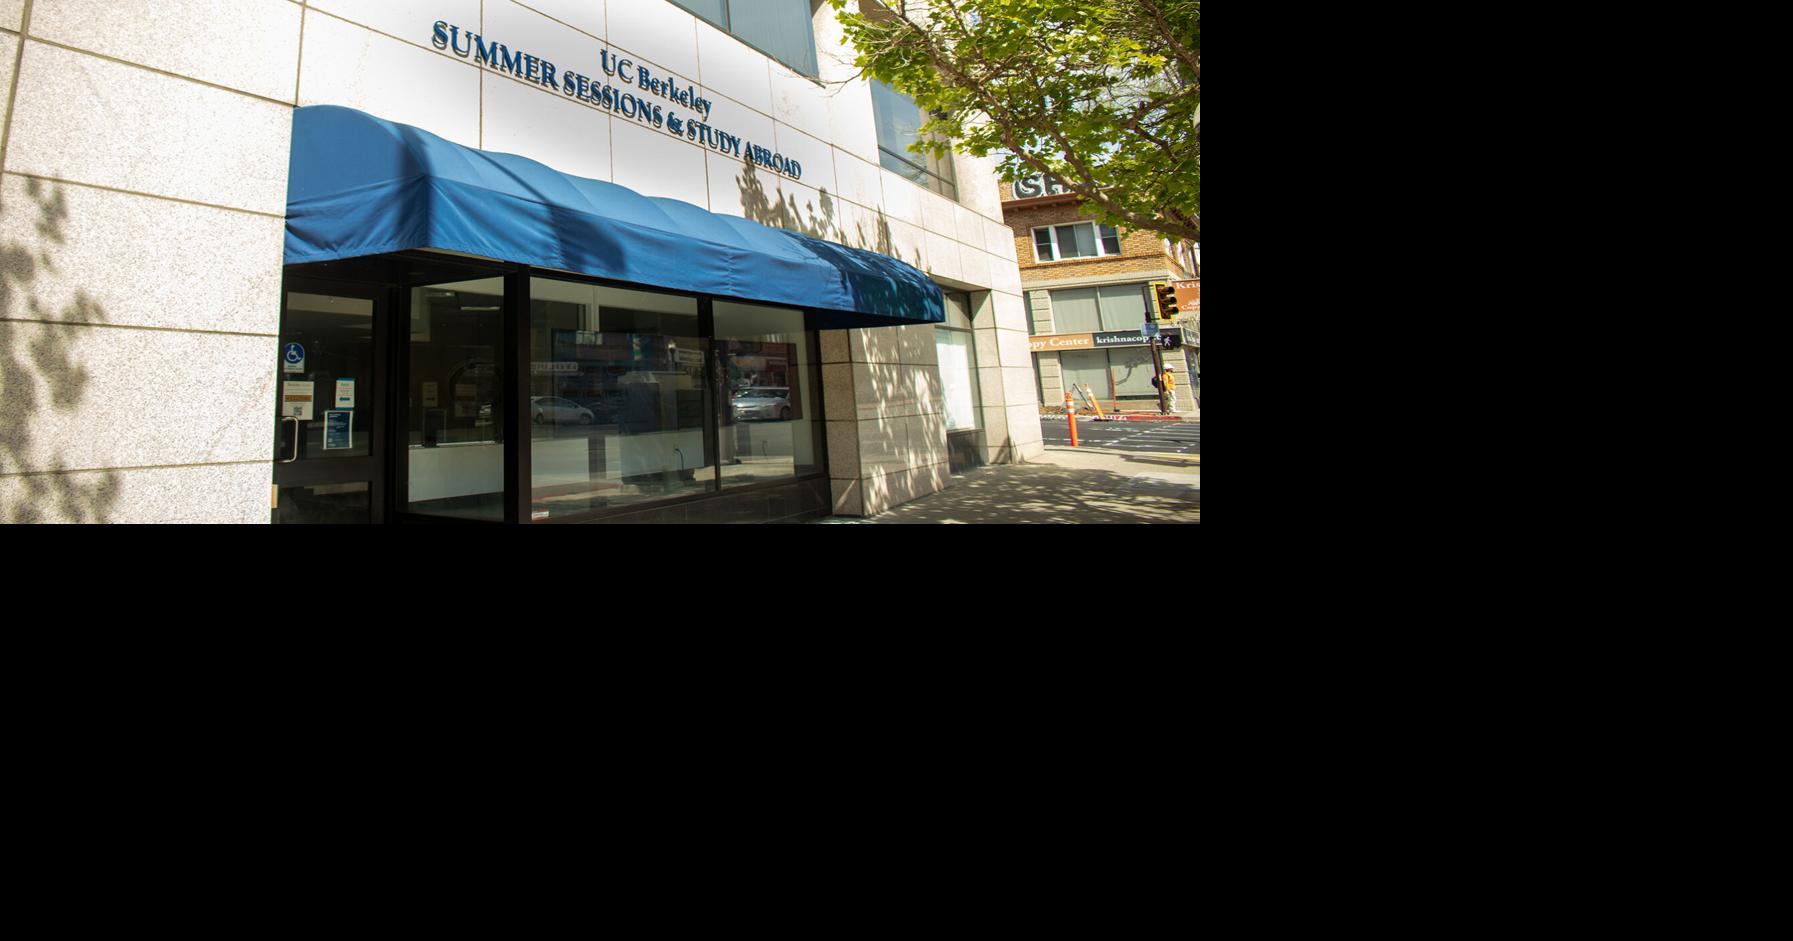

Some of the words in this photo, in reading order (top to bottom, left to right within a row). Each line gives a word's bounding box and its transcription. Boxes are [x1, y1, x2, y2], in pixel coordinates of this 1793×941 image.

[432, 20, 560, 91] SUMMER
[562, 70, 664, 128] SESSIONS
[666, 111, 685, 136] &
[686, 118, 742, 158] STUDY
[743, 141, 802, 180] ABROAD
[600, 48, 633, 84] UC
[637, 64, 712, 121] Berkeley
[1049, 337, 1089, 347] Center
